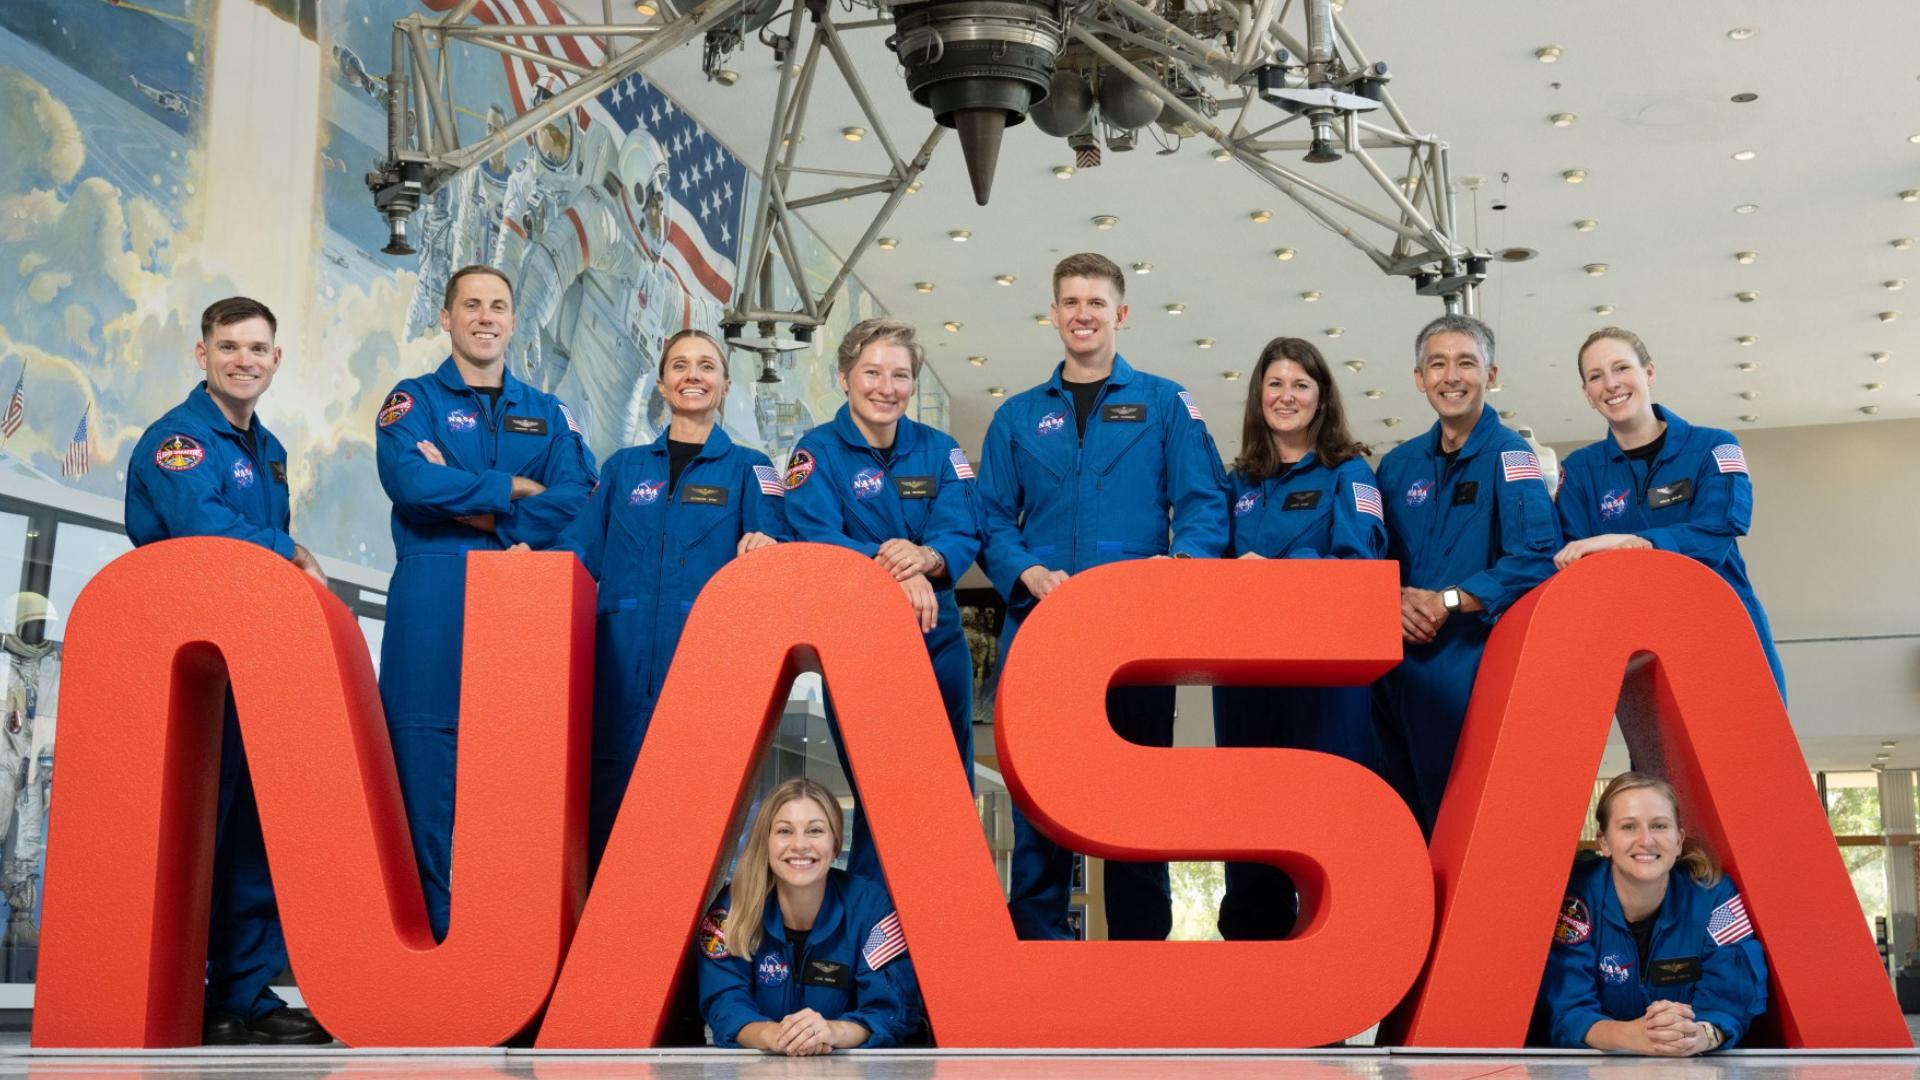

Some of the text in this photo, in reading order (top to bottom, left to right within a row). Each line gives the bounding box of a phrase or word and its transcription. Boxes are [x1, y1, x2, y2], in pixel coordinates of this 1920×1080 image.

[853, 477, 883, 490] NASA
[30, 536, 1914, 1049] NASA
[759, 964, 789, 974] NASA
[1600, 963, 1629, 977] NASA
